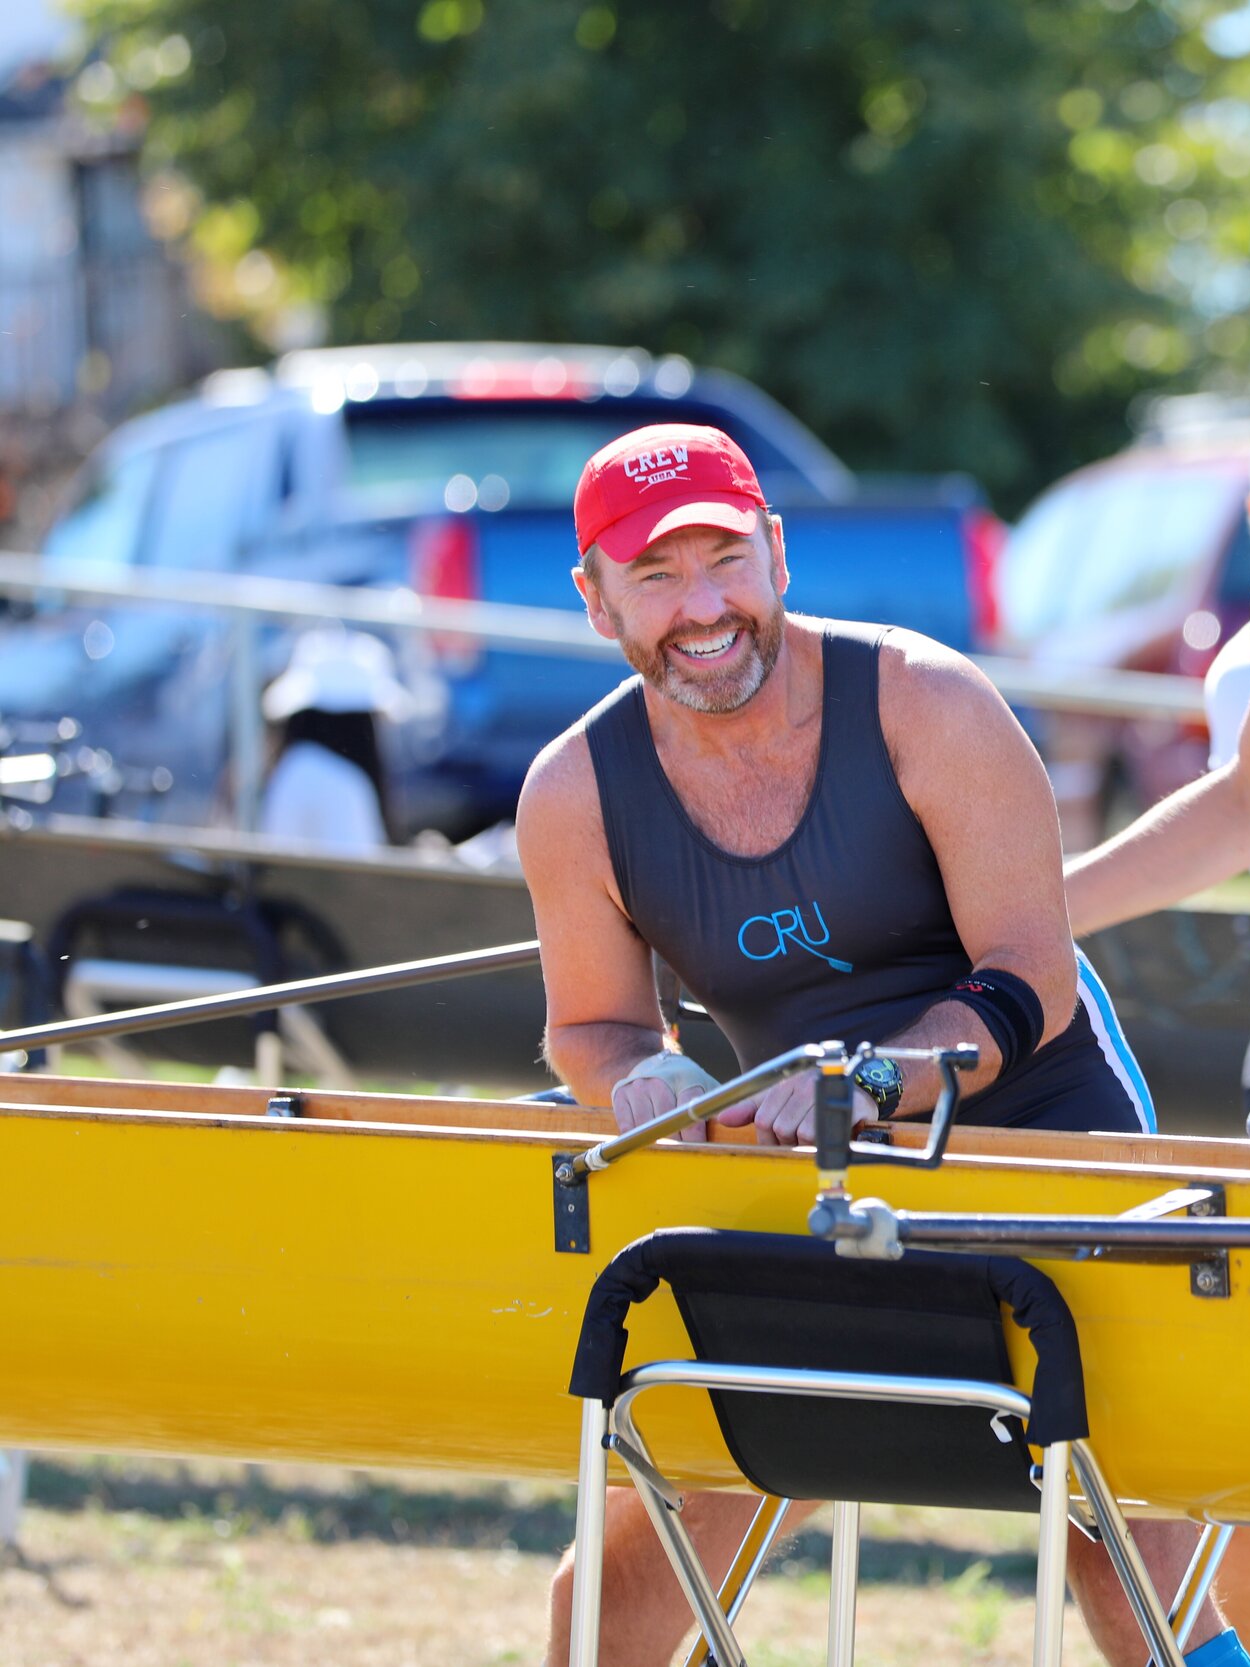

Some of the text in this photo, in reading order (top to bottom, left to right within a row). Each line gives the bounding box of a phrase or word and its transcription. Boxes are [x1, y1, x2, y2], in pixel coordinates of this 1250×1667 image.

[623, 445, 689, 477] CREW
[650, 471, 673, 483] USA
[737, 901, 853, 973] CRU
